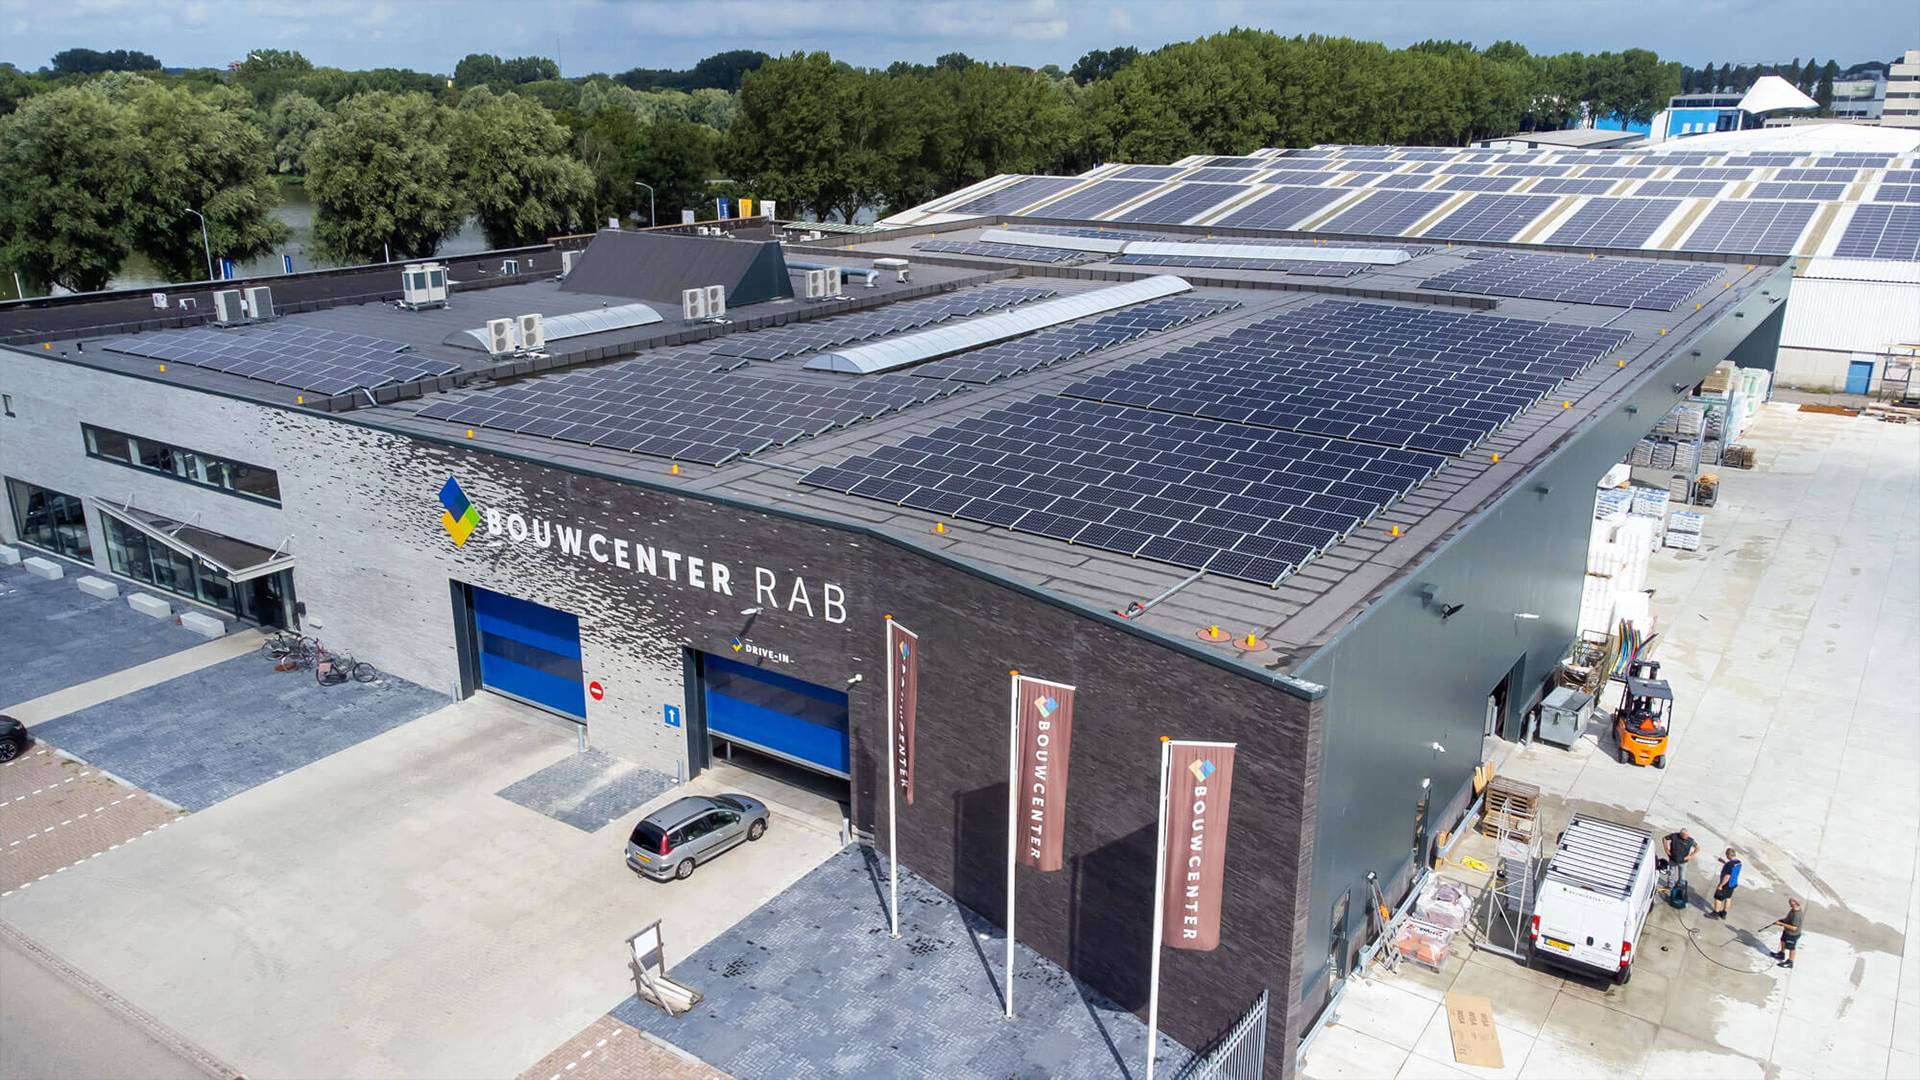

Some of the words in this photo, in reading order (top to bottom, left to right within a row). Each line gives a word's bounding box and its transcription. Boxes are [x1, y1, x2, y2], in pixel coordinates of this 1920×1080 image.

[487, 508, 733, 596] BOUWCENTER
[755, 566, 847, 624] RAB
[745, 643, 789, 663] DRIVE-IN
[1030, 721, 1051, 859] BOUWCENTER
[1183, 785, 1208, 939] BOUWCENTER
